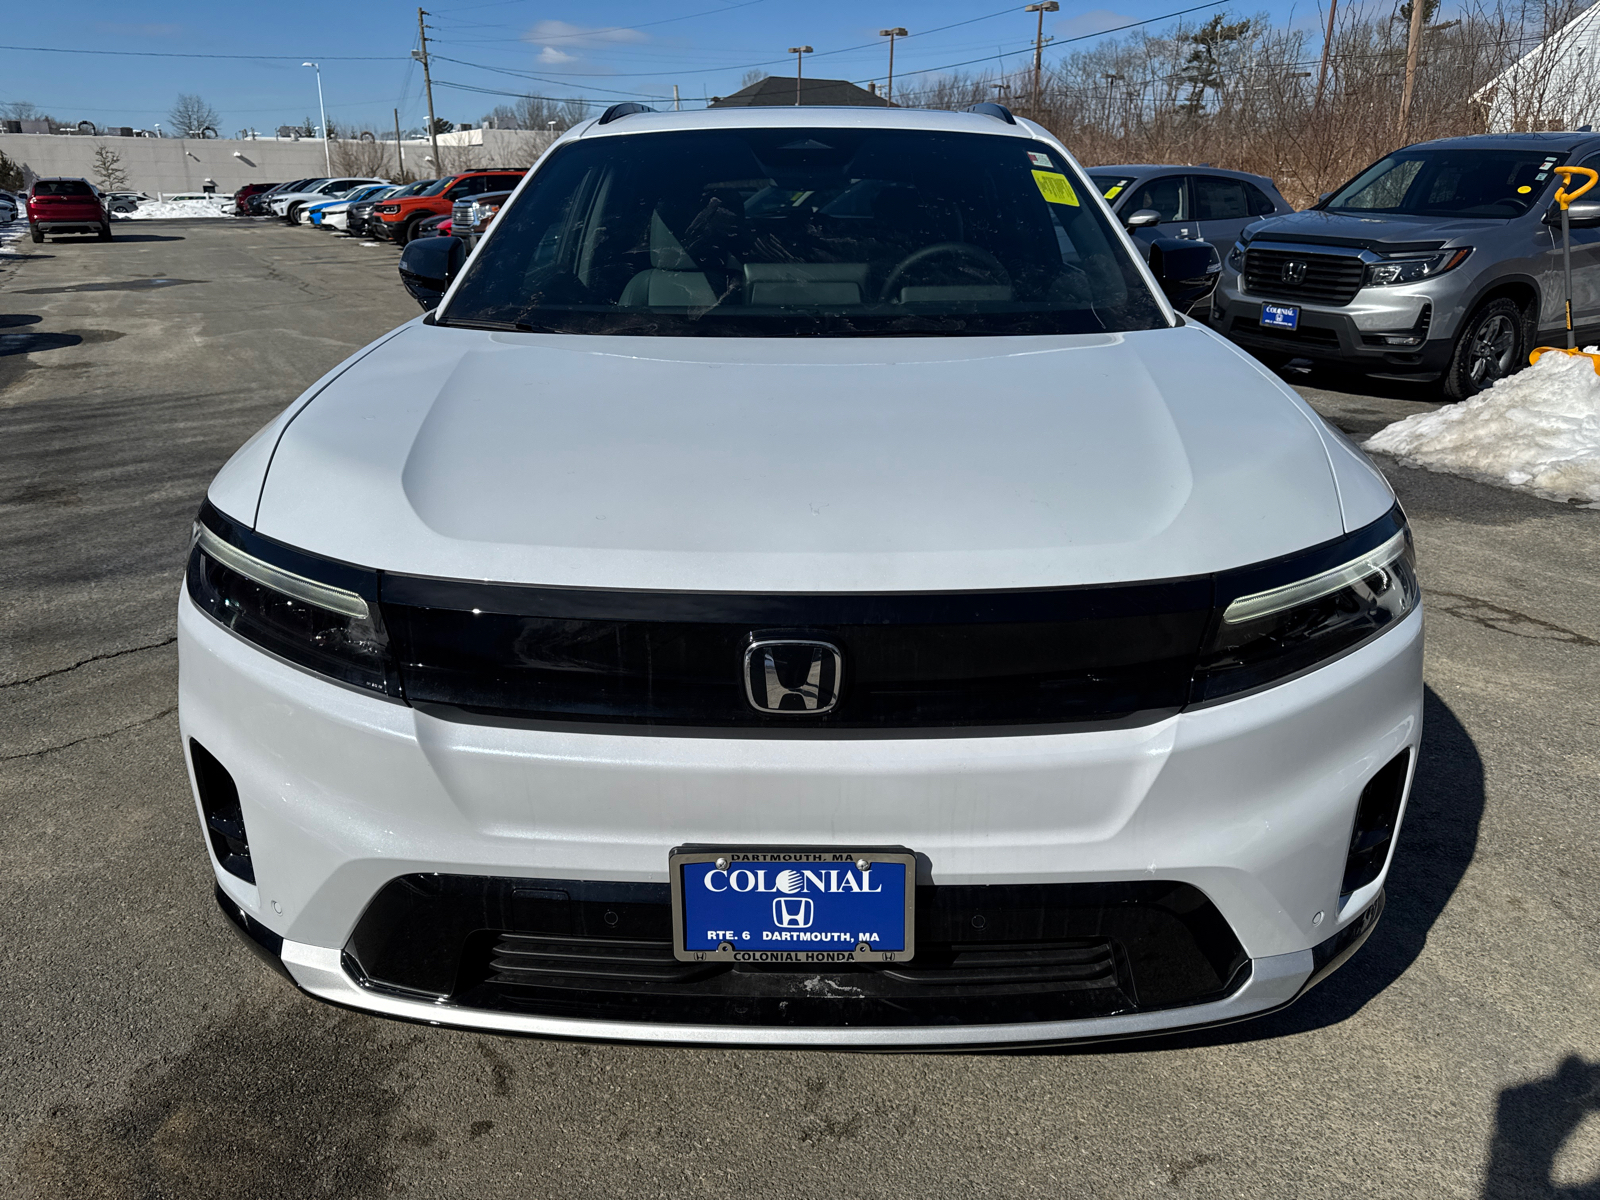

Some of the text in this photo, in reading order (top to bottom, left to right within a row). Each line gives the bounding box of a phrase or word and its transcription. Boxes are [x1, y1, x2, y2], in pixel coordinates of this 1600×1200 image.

[731, 854, 854, 862] DARTMOUTH, MA
[703, 869, 882, 894] COLONIAL
[707, 930, 880, 943] RTE. 6 DARTMOUTH, MA
[733, 952, 855, 962] COLONIAL HONDA
